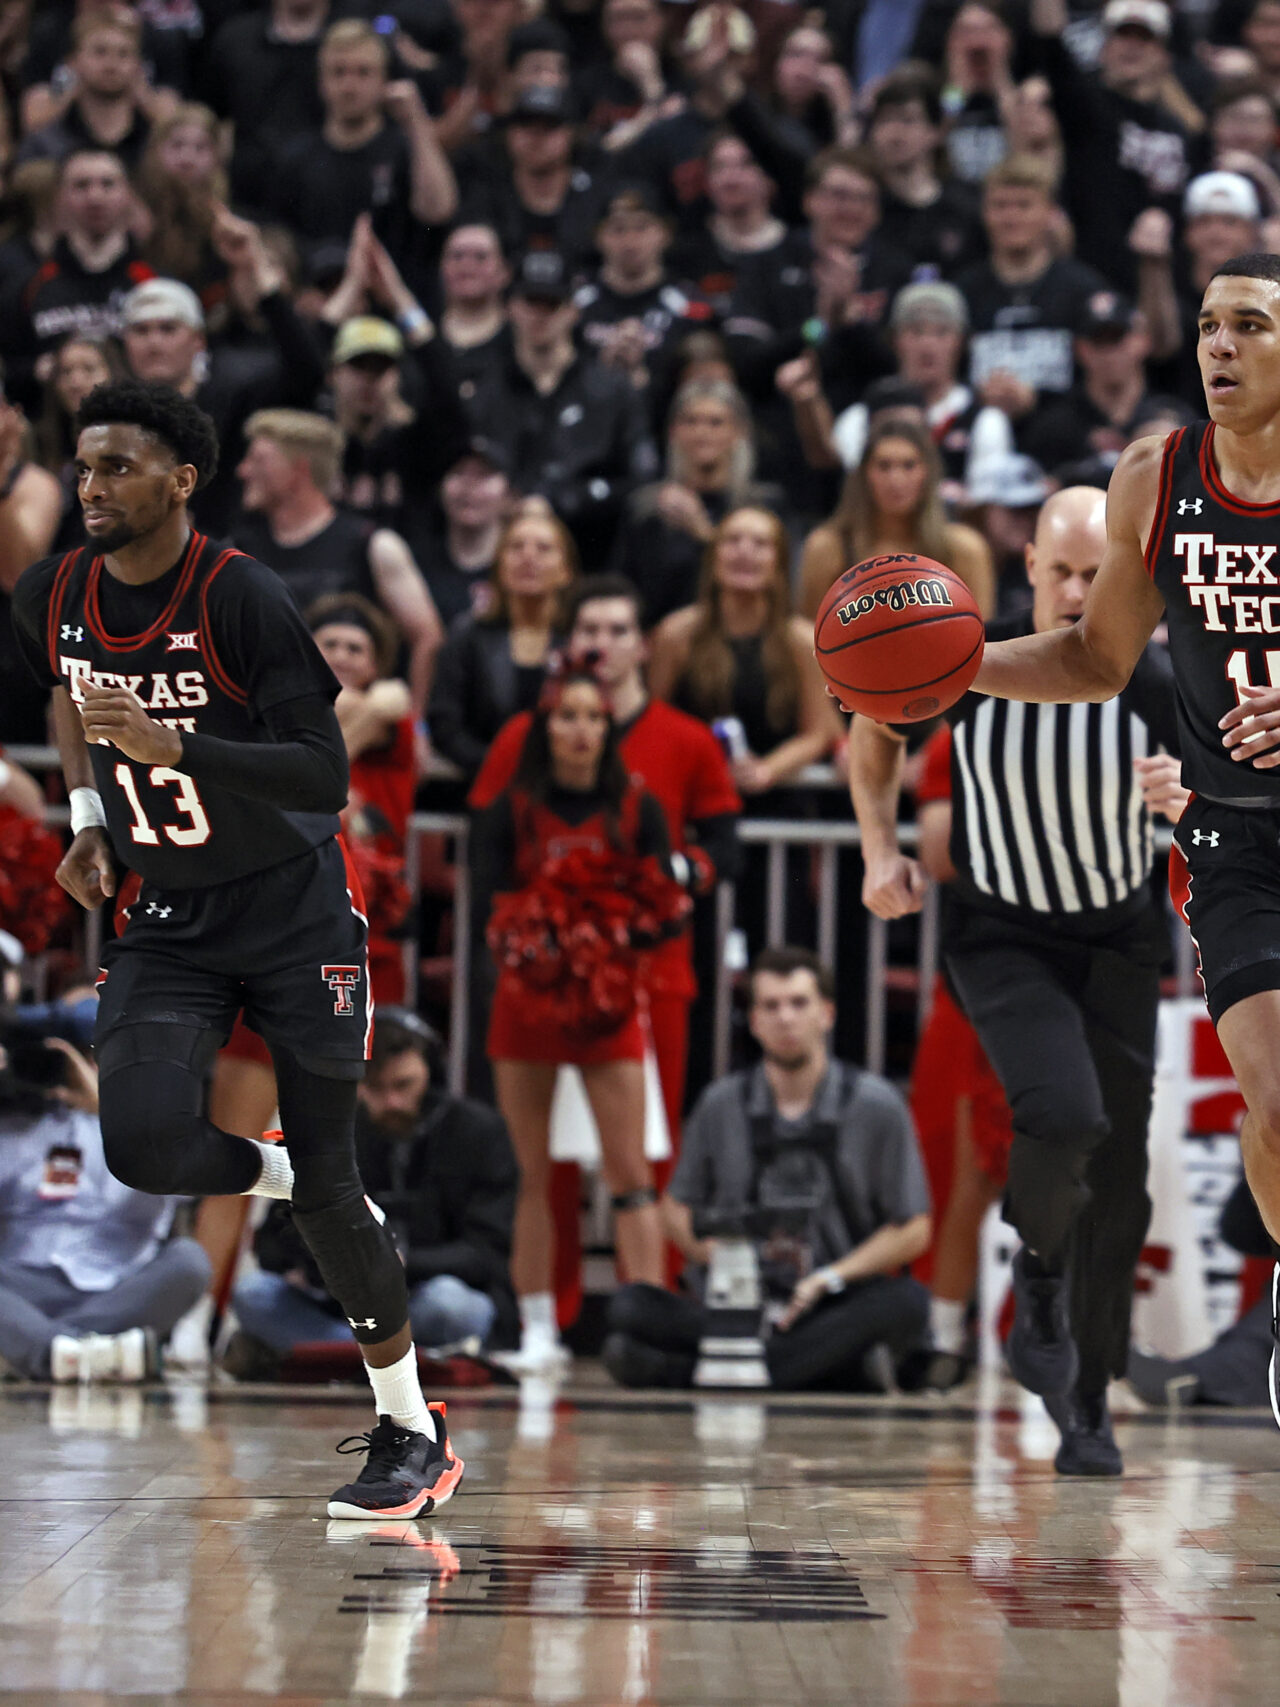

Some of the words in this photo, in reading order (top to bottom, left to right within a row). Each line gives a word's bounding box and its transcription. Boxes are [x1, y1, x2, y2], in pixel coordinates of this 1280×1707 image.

[836, 578, 953, 626] Wilson
[167, 632, 199, 650] XII
[114, 763, 212, 846] 13
